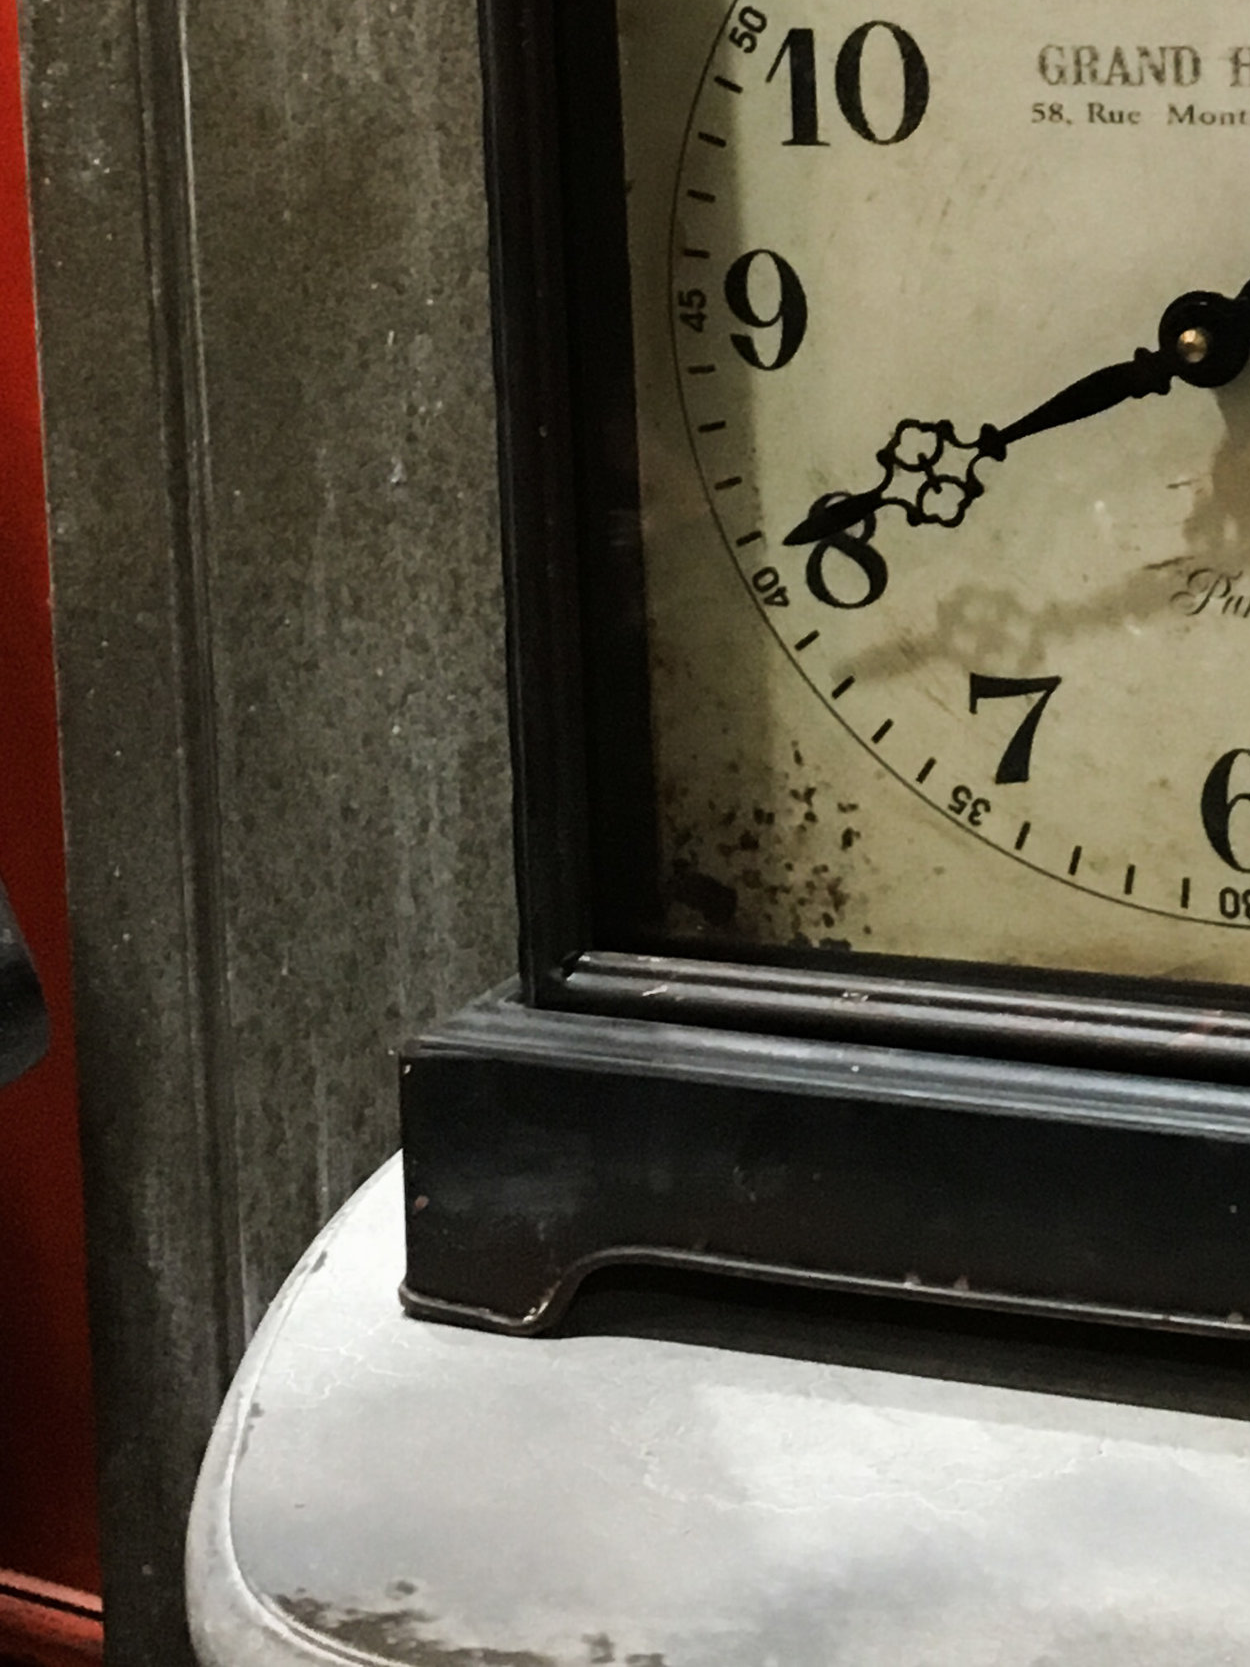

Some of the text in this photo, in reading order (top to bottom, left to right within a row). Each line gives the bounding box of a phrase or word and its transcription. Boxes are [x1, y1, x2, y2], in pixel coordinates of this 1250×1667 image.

[727, 5, 768, 54] 50
[765, 19, 931, 147] 10
[1036, 44, 1202, 87] GRAND
[1031, 102, 1072, 126] 58,
[1087, 103, 1142, 126] Rue
[677, 287, 709, 332] 45
[722, 249, 808, 371] 9
[806, 491, 889, 610] 8
[751, 566, 790, 608] 40
[969, 672, 1063, 785] 7
[947, 784, 992, 827] 35
